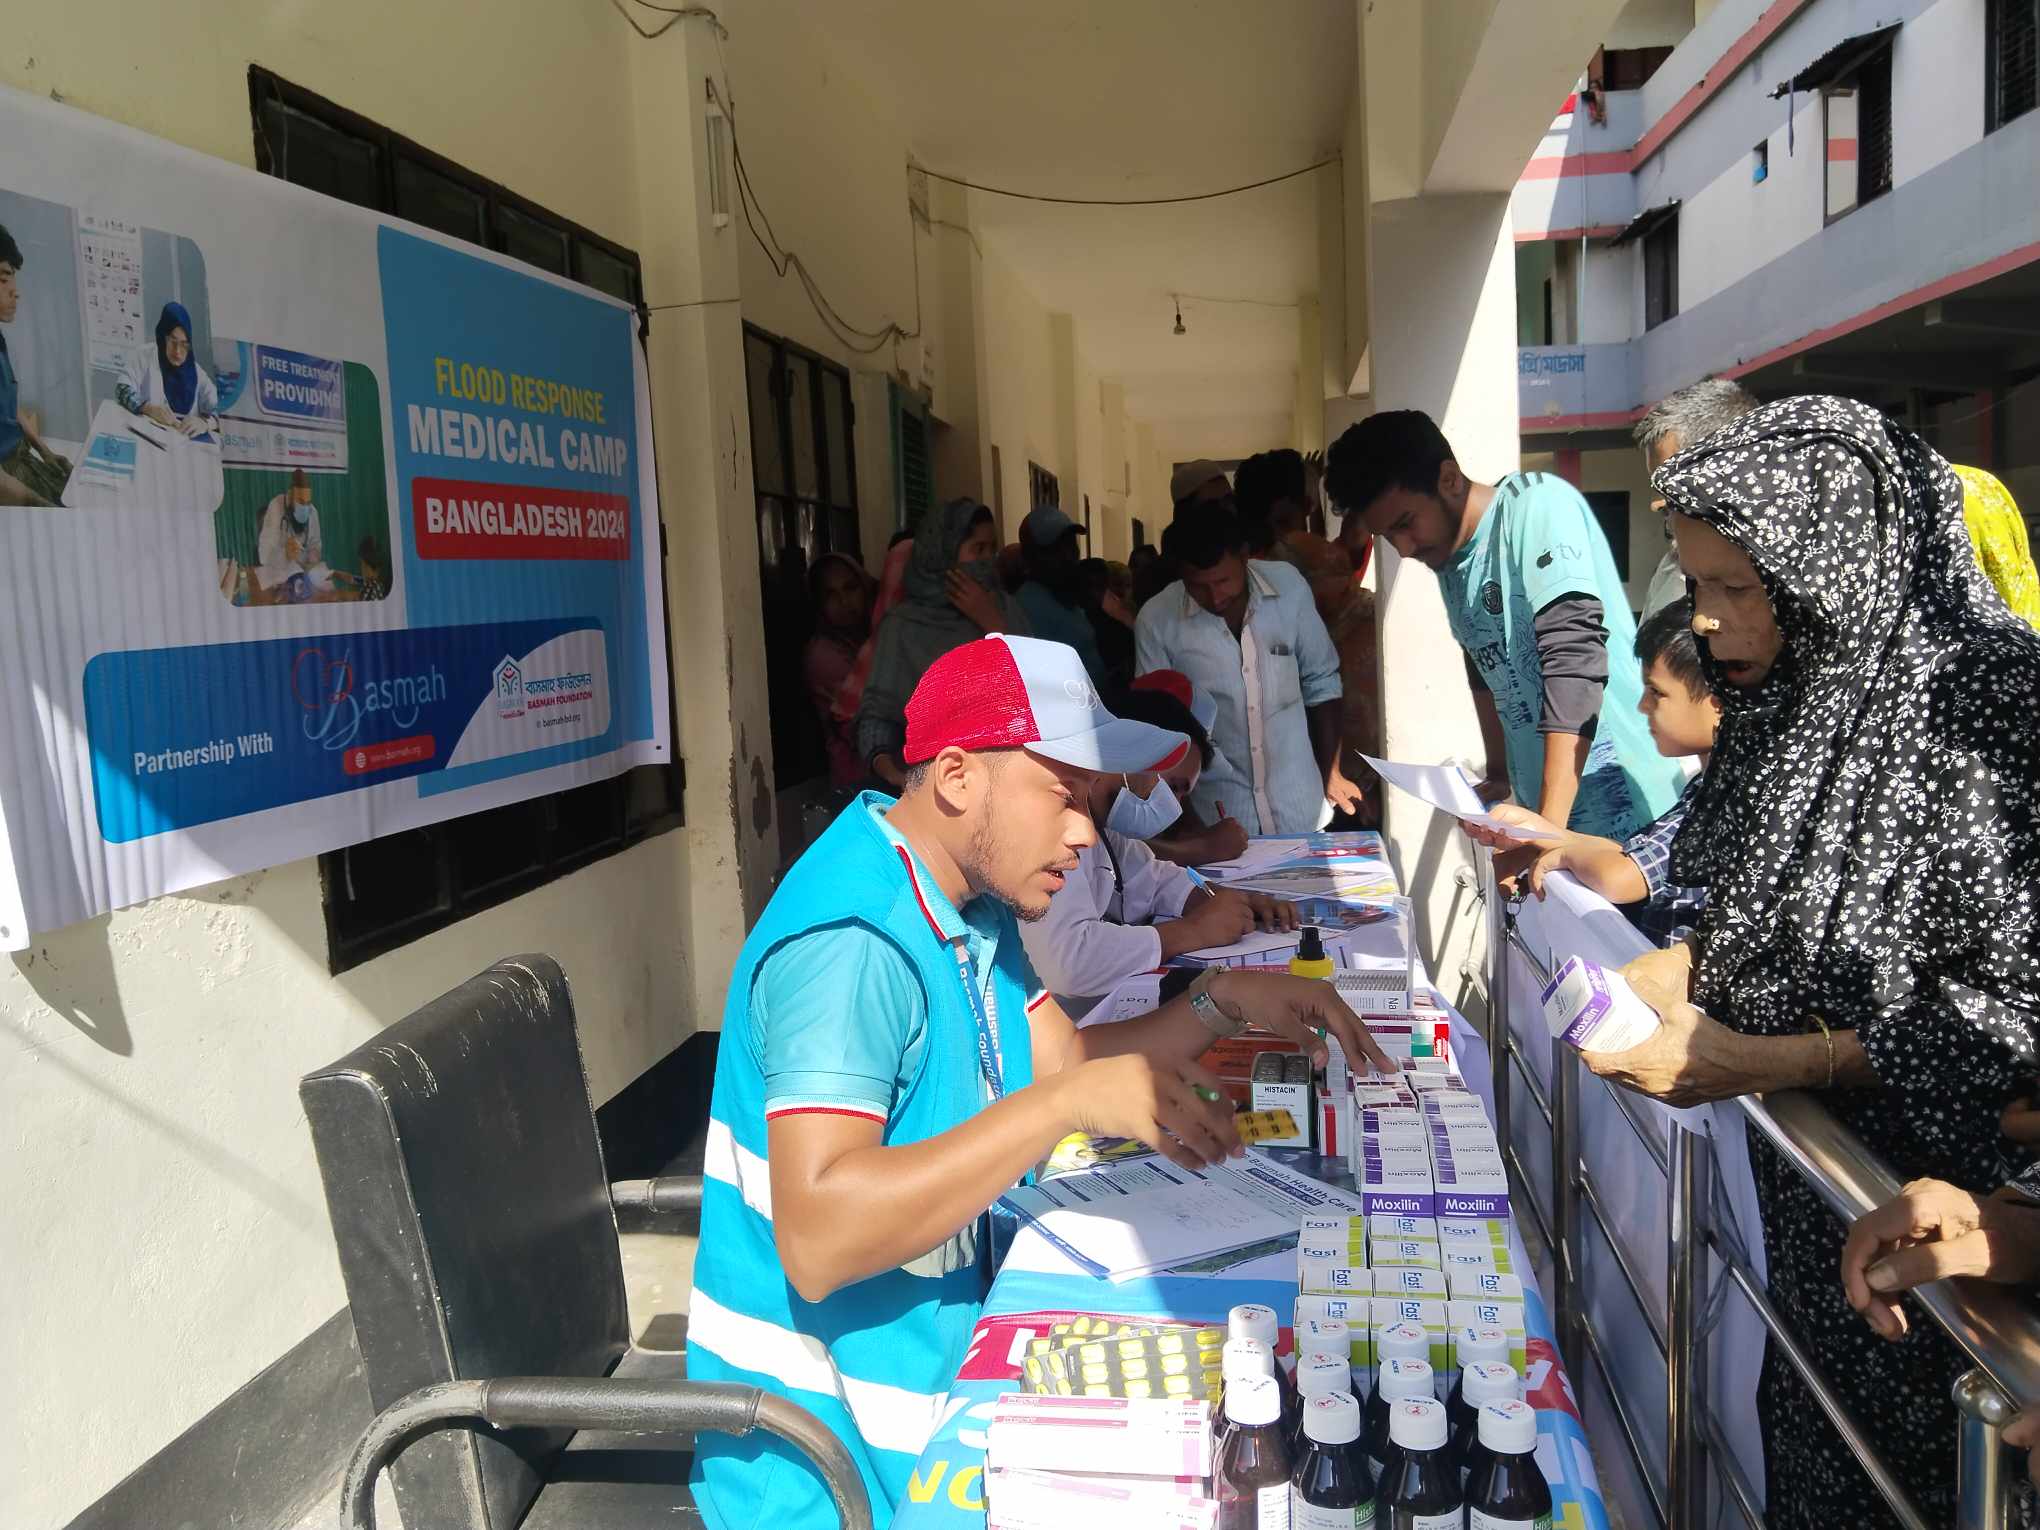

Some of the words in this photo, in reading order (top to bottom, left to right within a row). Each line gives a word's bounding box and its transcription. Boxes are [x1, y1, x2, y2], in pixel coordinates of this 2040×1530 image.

[262, 355, 289, 373] FREE
[263, 378, 340, 408] PROVIDING
[434, 357, 506, 406] FLOOD
[510, 374, 606, 424] RESPONSE
[407, 404, 555, 468] MEDICAL
[560, 429, 628, 477] CAMP
[426, 497, 584, 538] BANGLADESH
[587, 508, 625, 539] 2024
[292, 648, 446, 750] Basmah
[527, 697, 556, 710] BASMAH
[133, 739, 235, 775] Partnership
[237, 732, 273, 757] With
[1569, 1007, 1599, 1040] Moxilin
[1264, 1086, 1296, 1094] HISTACIN
[1290, 1179, 1329, 1200] Health
[1328, 1198, 1357, 1212] Care
[1371, 1198, 1421, 1211] Moxilin
[1445, 1198, 1495, 1211] Moxilin
[1402, 1218, 1416, 1233] Fast
[1444, 1226, 1476, 1235] Fast
[1303, 1248, 1336, 1257] Fast
[1405, 1242, 1420, 1256] Fast
[1448, 1254, 1481, 1263] Fast
[1336, 1269, 1351, 1287] Fast
[1408, 1271, 1423, 1289] Fast
[1485, 1275, 1501, 1292] Fast
[1405, 1302, 1421, 1321] Fast
[1483, 1306, 1499, 1324] Fast
